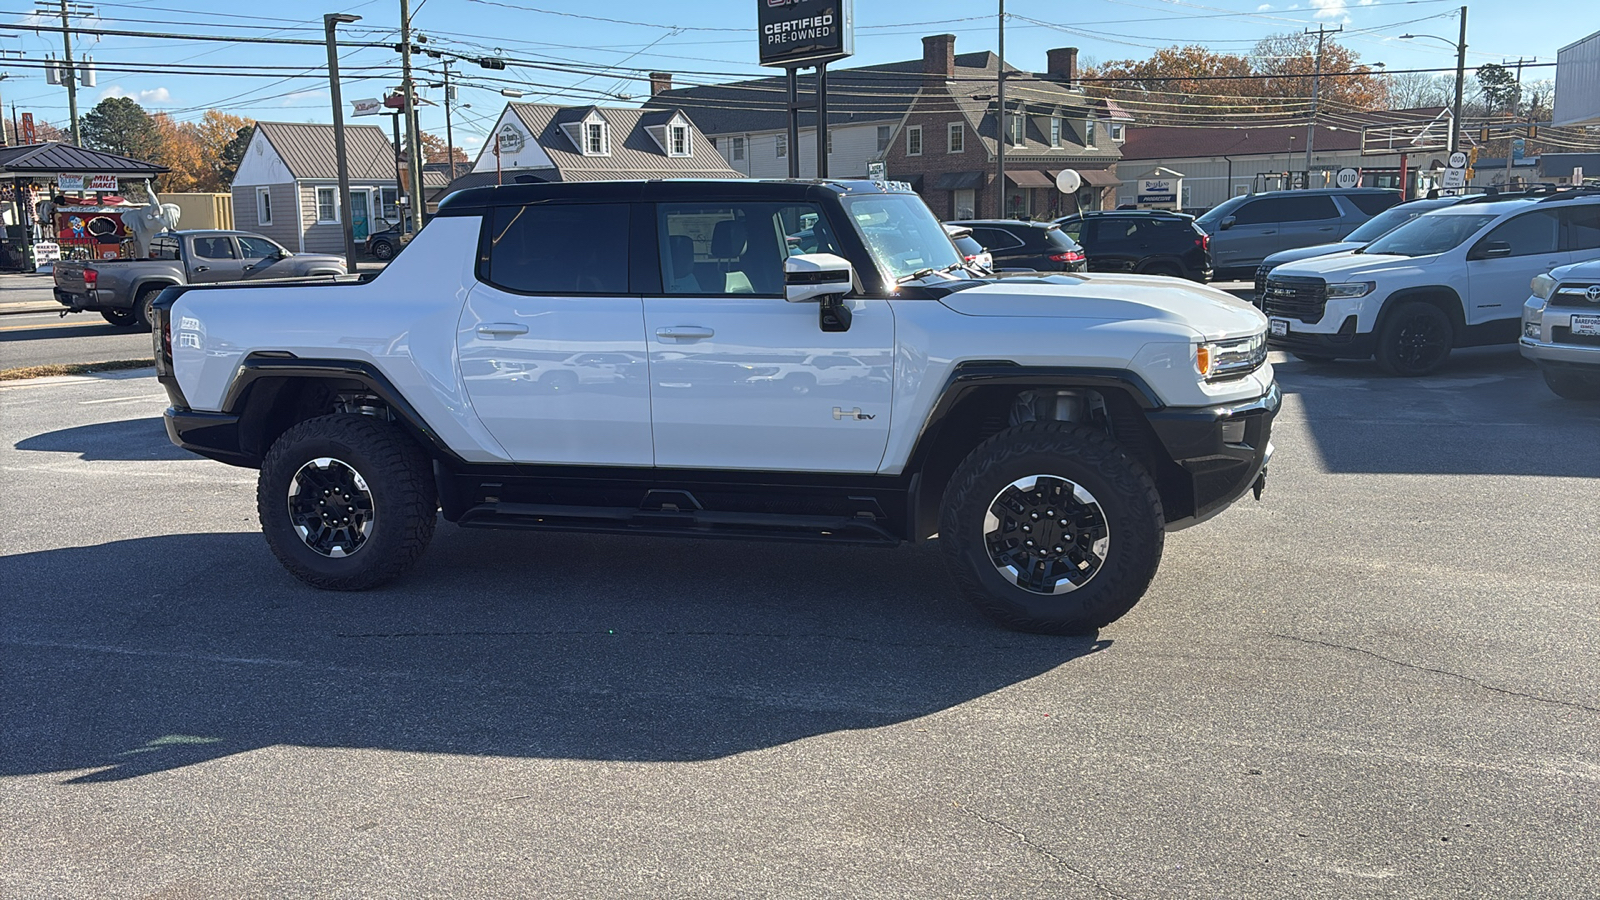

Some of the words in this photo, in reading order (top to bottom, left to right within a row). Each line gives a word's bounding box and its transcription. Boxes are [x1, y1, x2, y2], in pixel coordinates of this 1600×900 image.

[764, 14, 833, 35] CERTIFIED
[768, 26, 829, 45] PRE-OWNED
[1340, 174, 1356, 183] 1010
